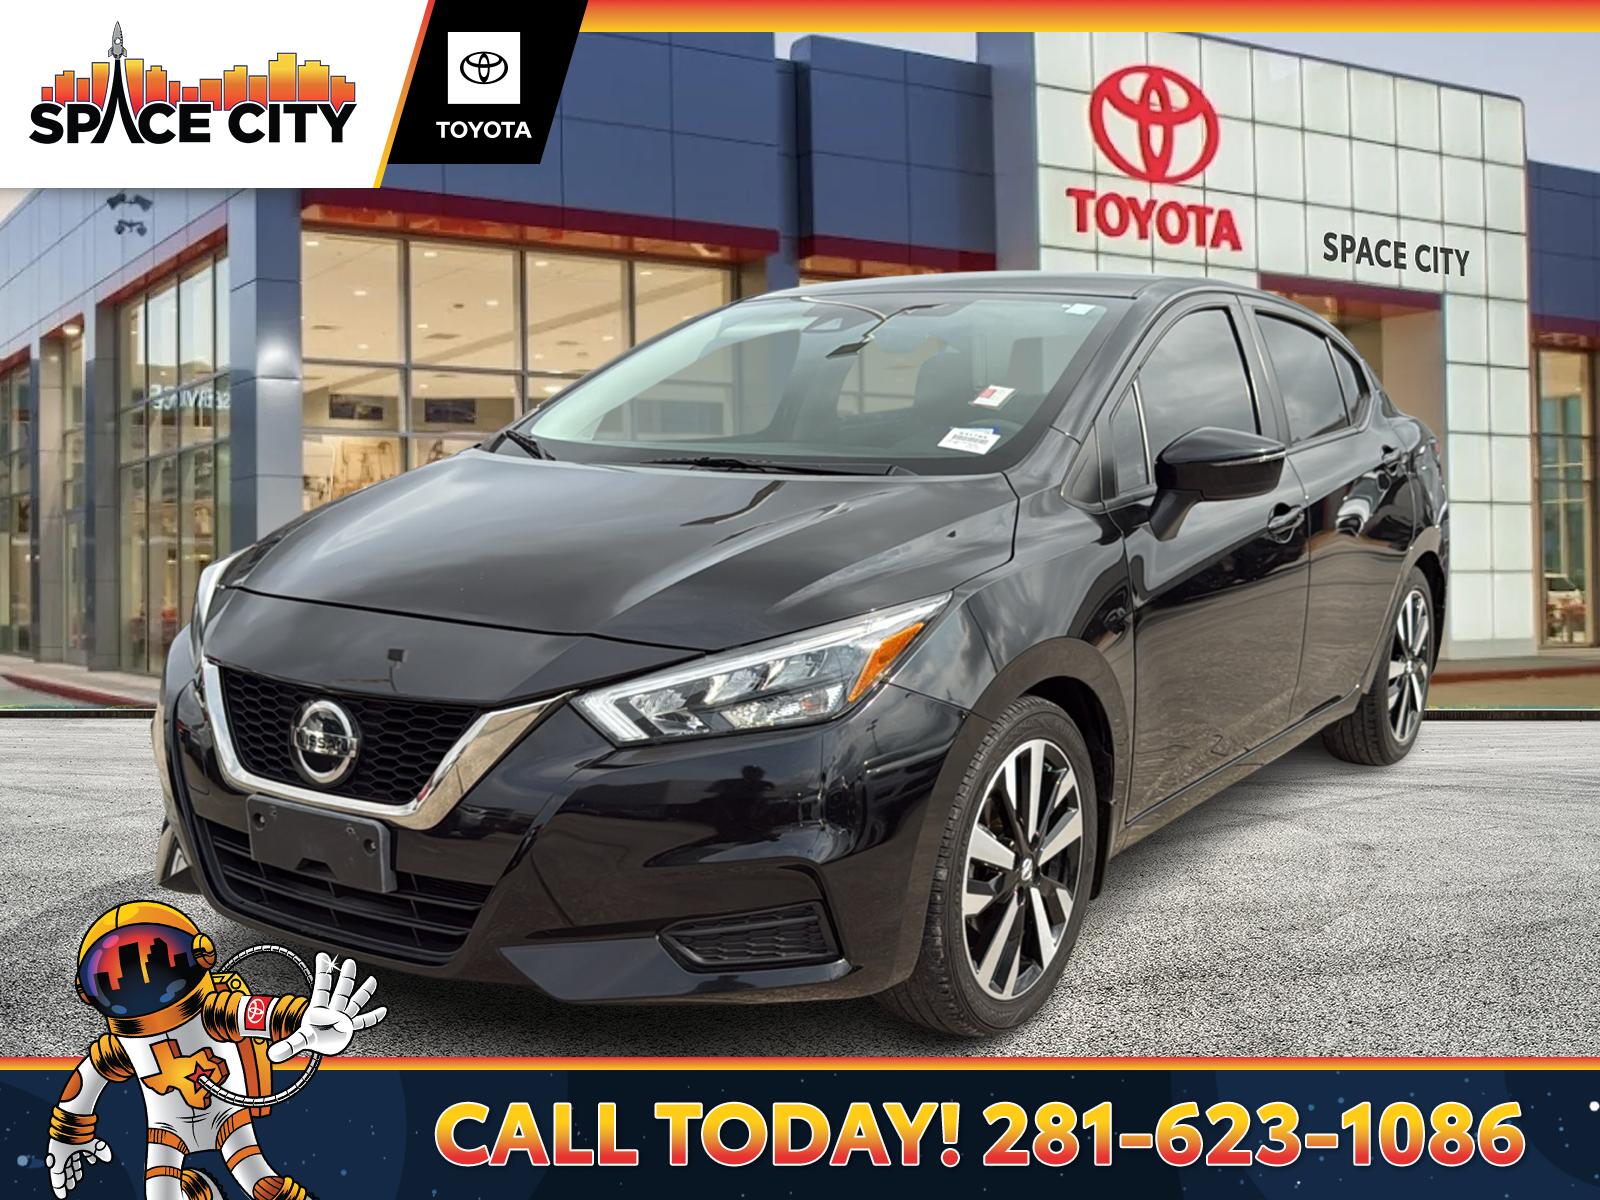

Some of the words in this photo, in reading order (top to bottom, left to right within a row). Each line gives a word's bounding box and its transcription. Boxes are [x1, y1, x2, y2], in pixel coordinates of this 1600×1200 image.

[1066, 187, 1243, 251] TOYOTA
[1322, 231, 1408, 271] SPACE
[1414, 243, 1470, 277] CITY
